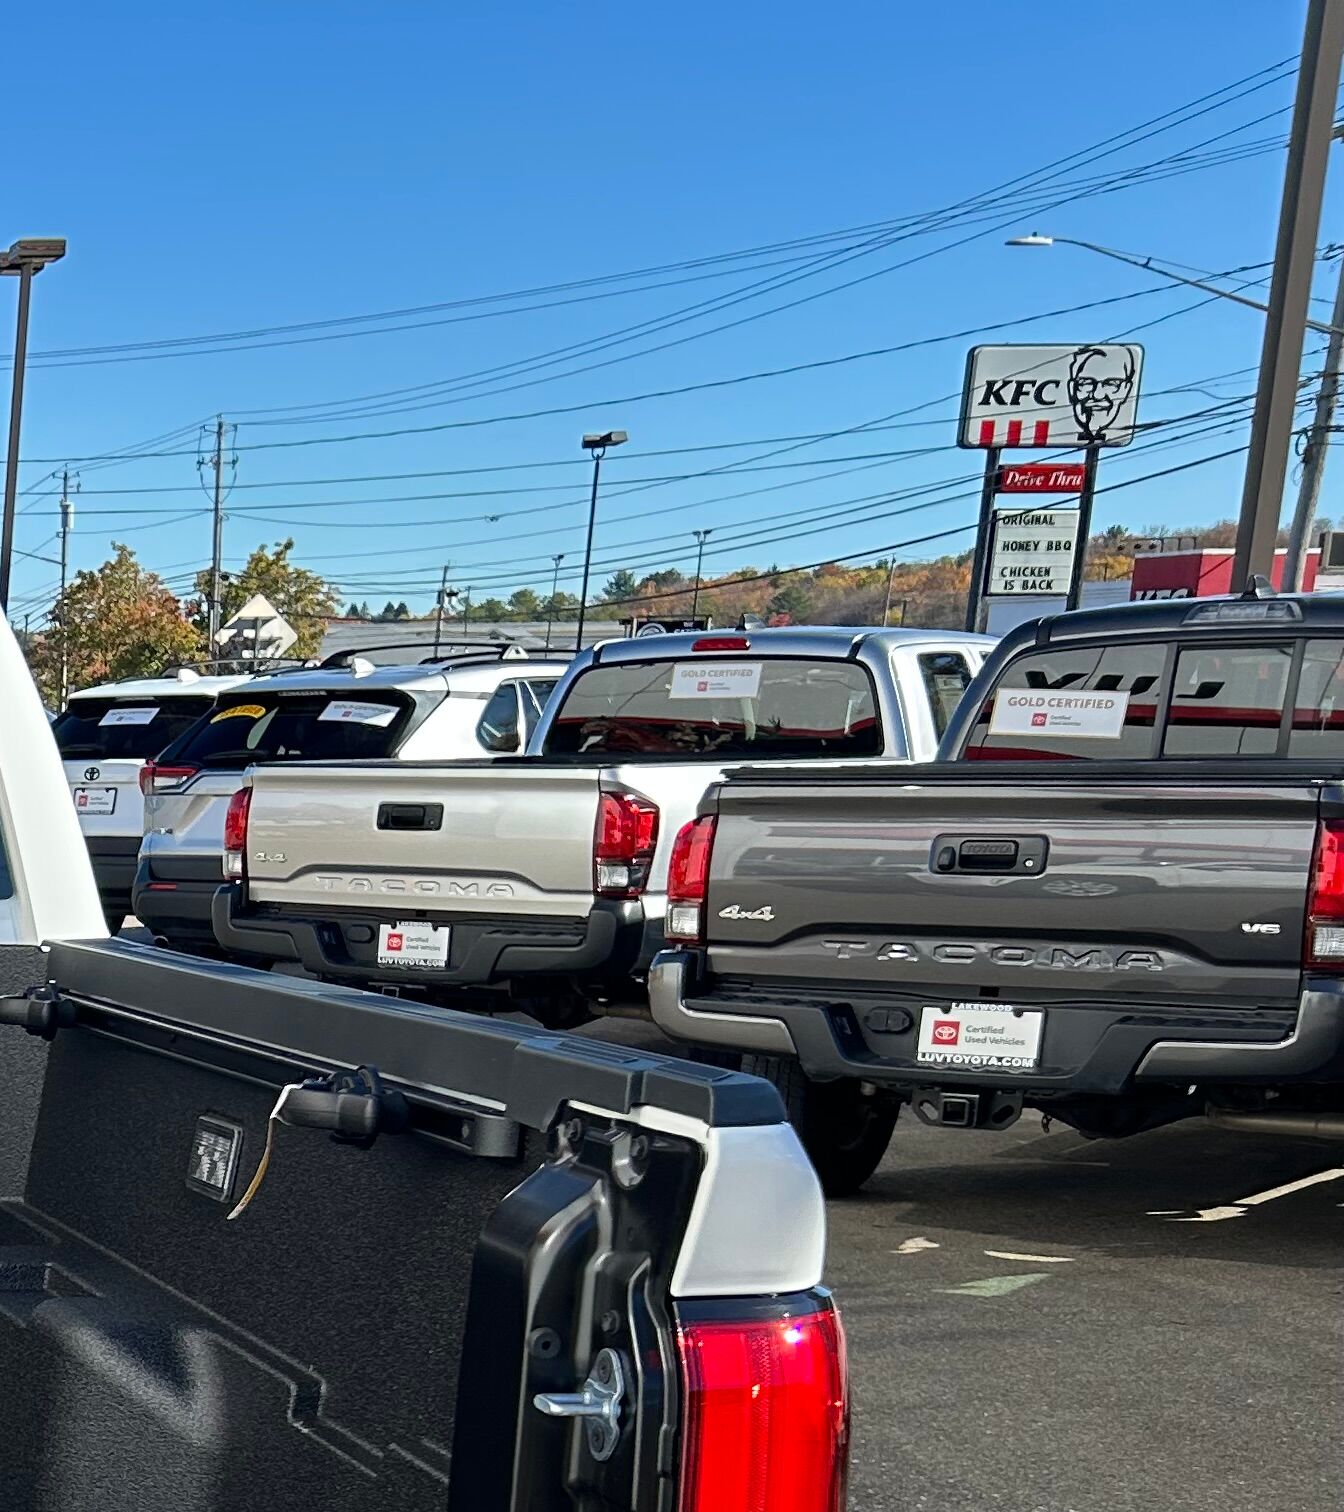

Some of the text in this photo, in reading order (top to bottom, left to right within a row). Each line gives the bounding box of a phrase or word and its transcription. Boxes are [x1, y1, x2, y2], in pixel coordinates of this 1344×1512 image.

[977, 379, 1061, 406] KFC
[1005, 470, 1082, 487] Drive Thru
[1002, 514, 1056, 526] ORIGINAL
[1002, 540, 1073, 552] HONEY BBQ
[1000, 566, 1051, 578] CHICKEN
[1003, 579, 1054, 591] IS BACK
[1007, 696, 1115, 709] GOLD CERTIFIED
[315, 875, 515, 898] TACOMA
[717, 903, 775, 922] 4x4
[1241, 922, 1281, 935] V6
[820, 939, 1164, 971] TACOMA
[965, 1024, 1006, 1035] Certified
[964, 1036, 1026, 1047] Used Vehicles
[916, 1051, 1035, 1069] LUVTOYOTA.COM
